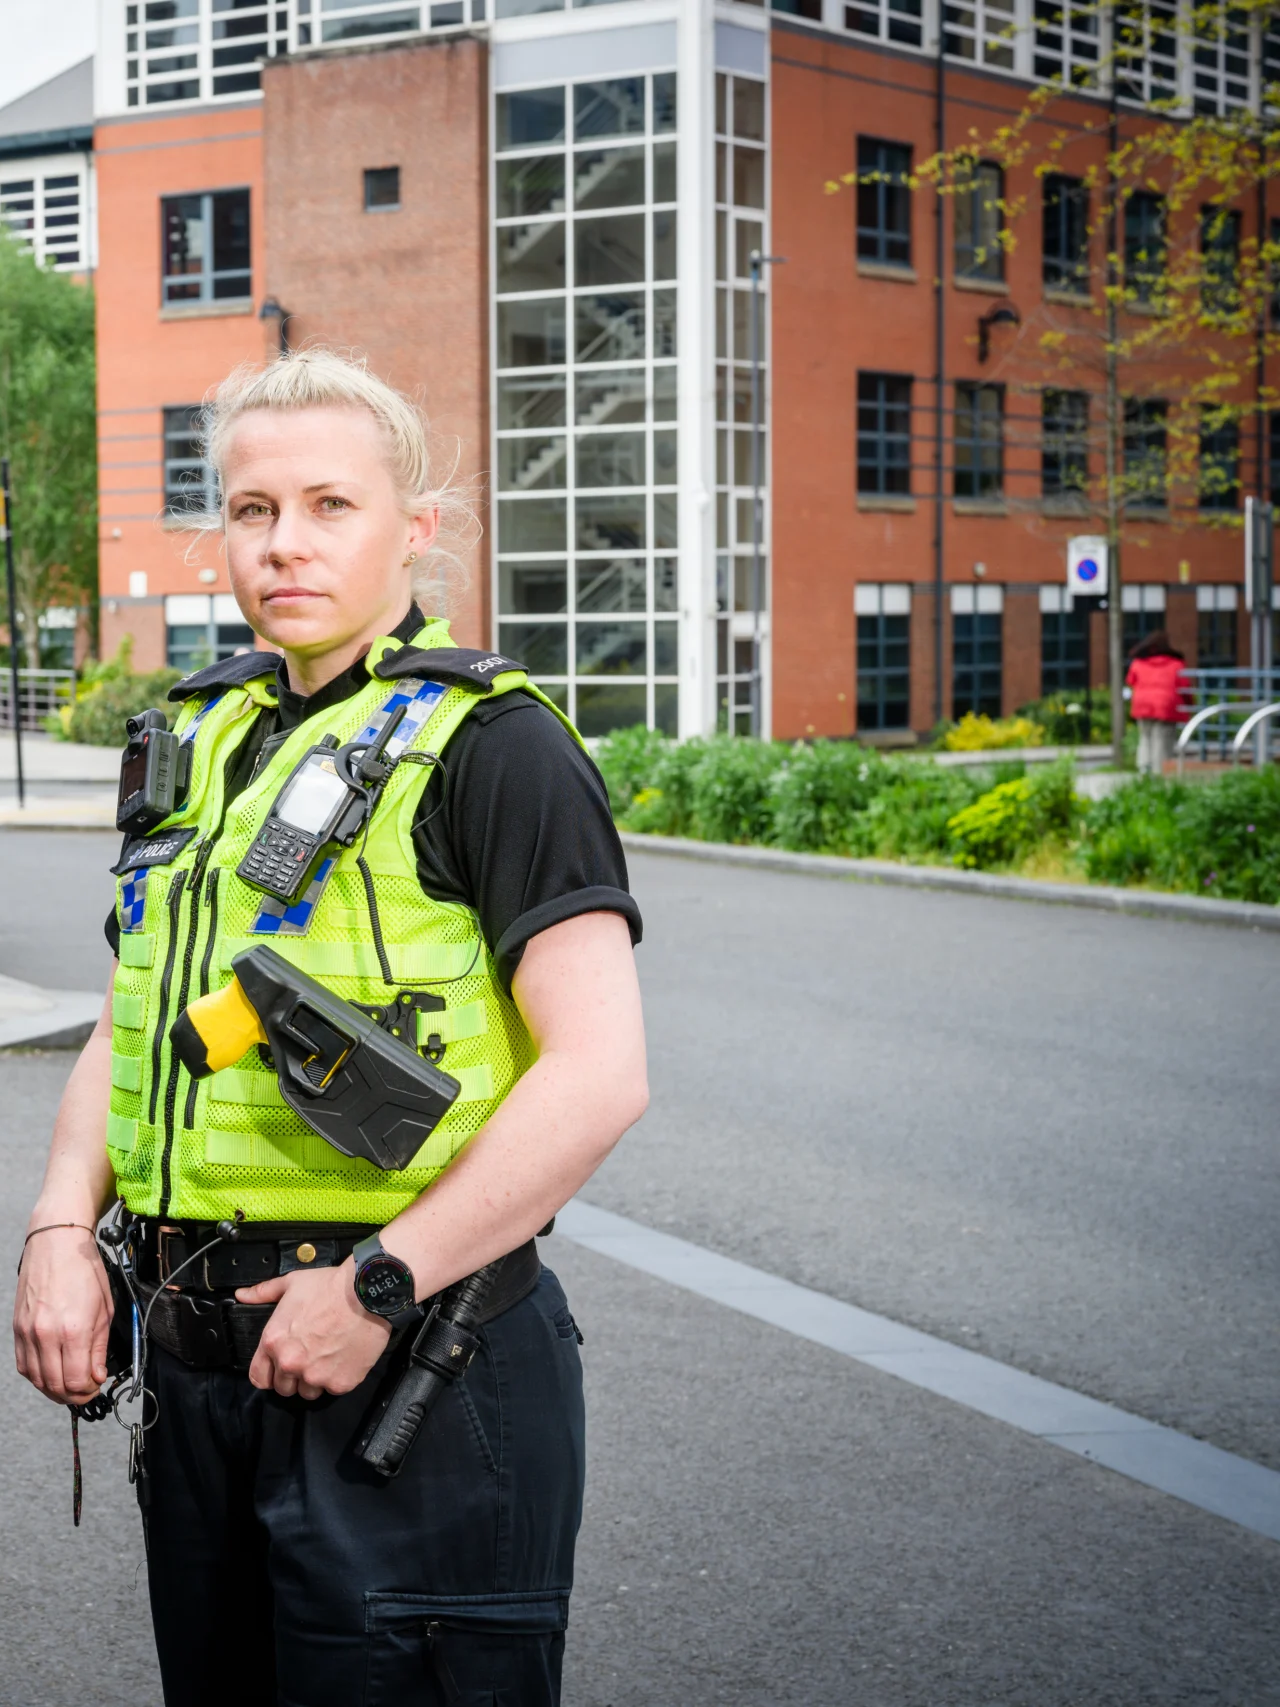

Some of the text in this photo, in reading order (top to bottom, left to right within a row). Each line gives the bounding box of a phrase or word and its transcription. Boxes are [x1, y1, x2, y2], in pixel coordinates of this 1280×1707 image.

[470, 656, 508, 673] 2007
[138, 841, 179, 859] POLICE
[368, 1274, 400, 1298] 13:18
